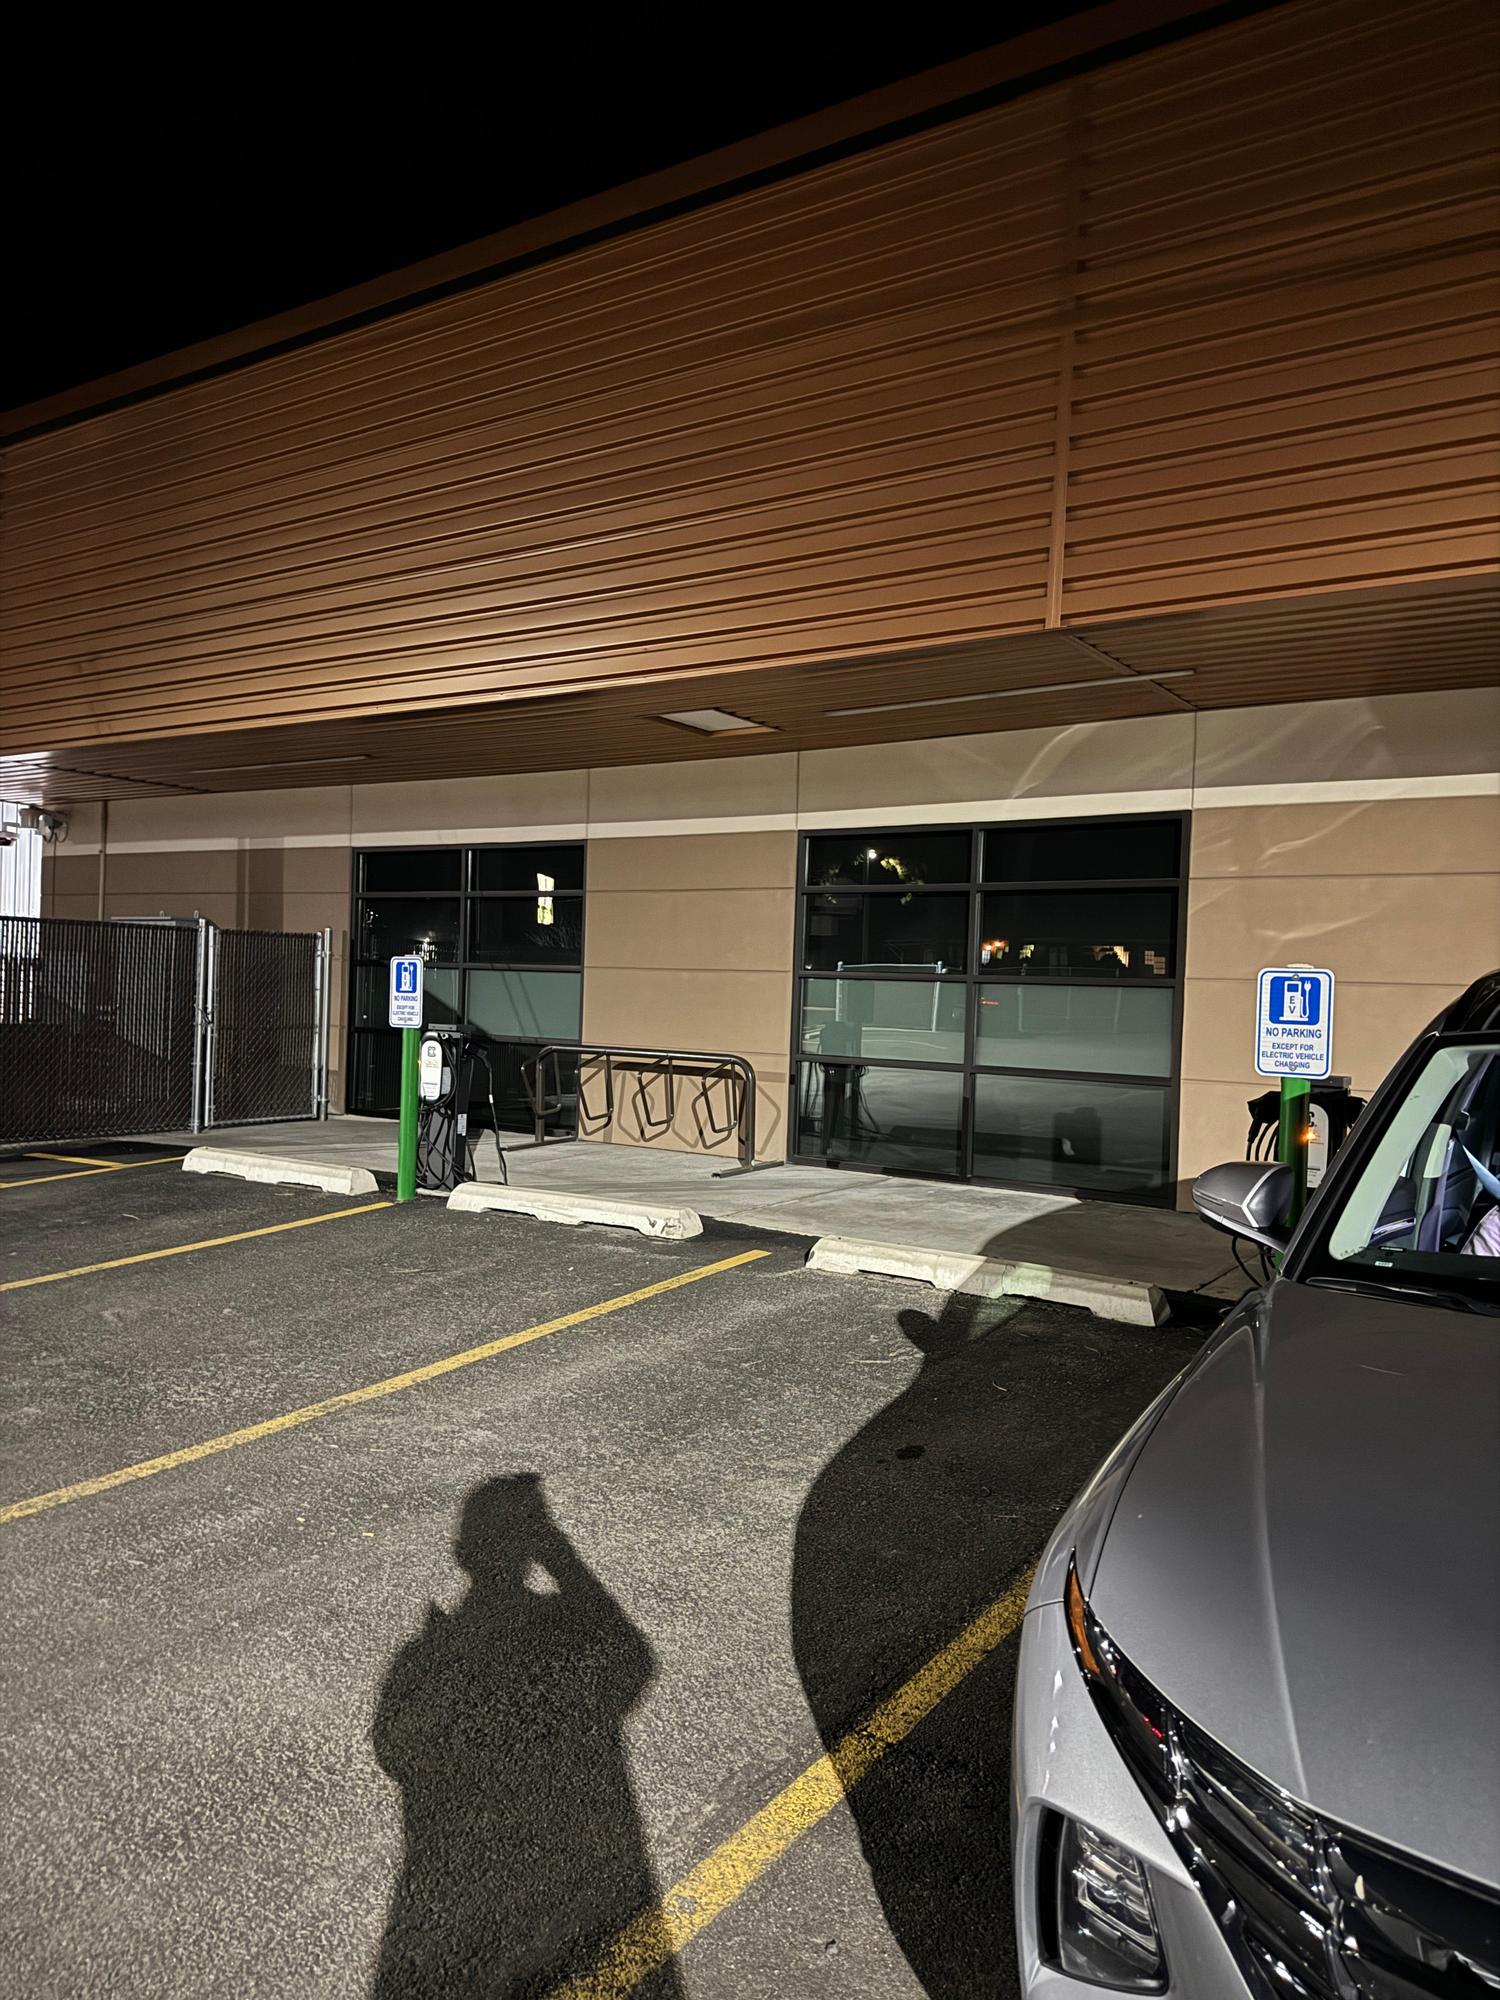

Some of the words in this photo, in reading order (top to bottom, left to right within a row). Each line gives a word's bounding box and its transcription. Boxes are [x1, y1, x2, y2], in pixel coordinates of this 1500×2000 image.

[1289, 995, 1296, 1014] EV
[1266, 1027, 1279, 1037] NO
[1281, 1028, 1322, 1039] PARKING
[1272, 1042, 1298, 1051] EXCEPT
[1300, 1043, 1314, 1051] FOR
[1261, 1051, 1294, 1059] ELECTRIC
[1296, 1053, 1324, 1061] VEHICLE
[1274, 1060, 1310, 1069] CHARGING
